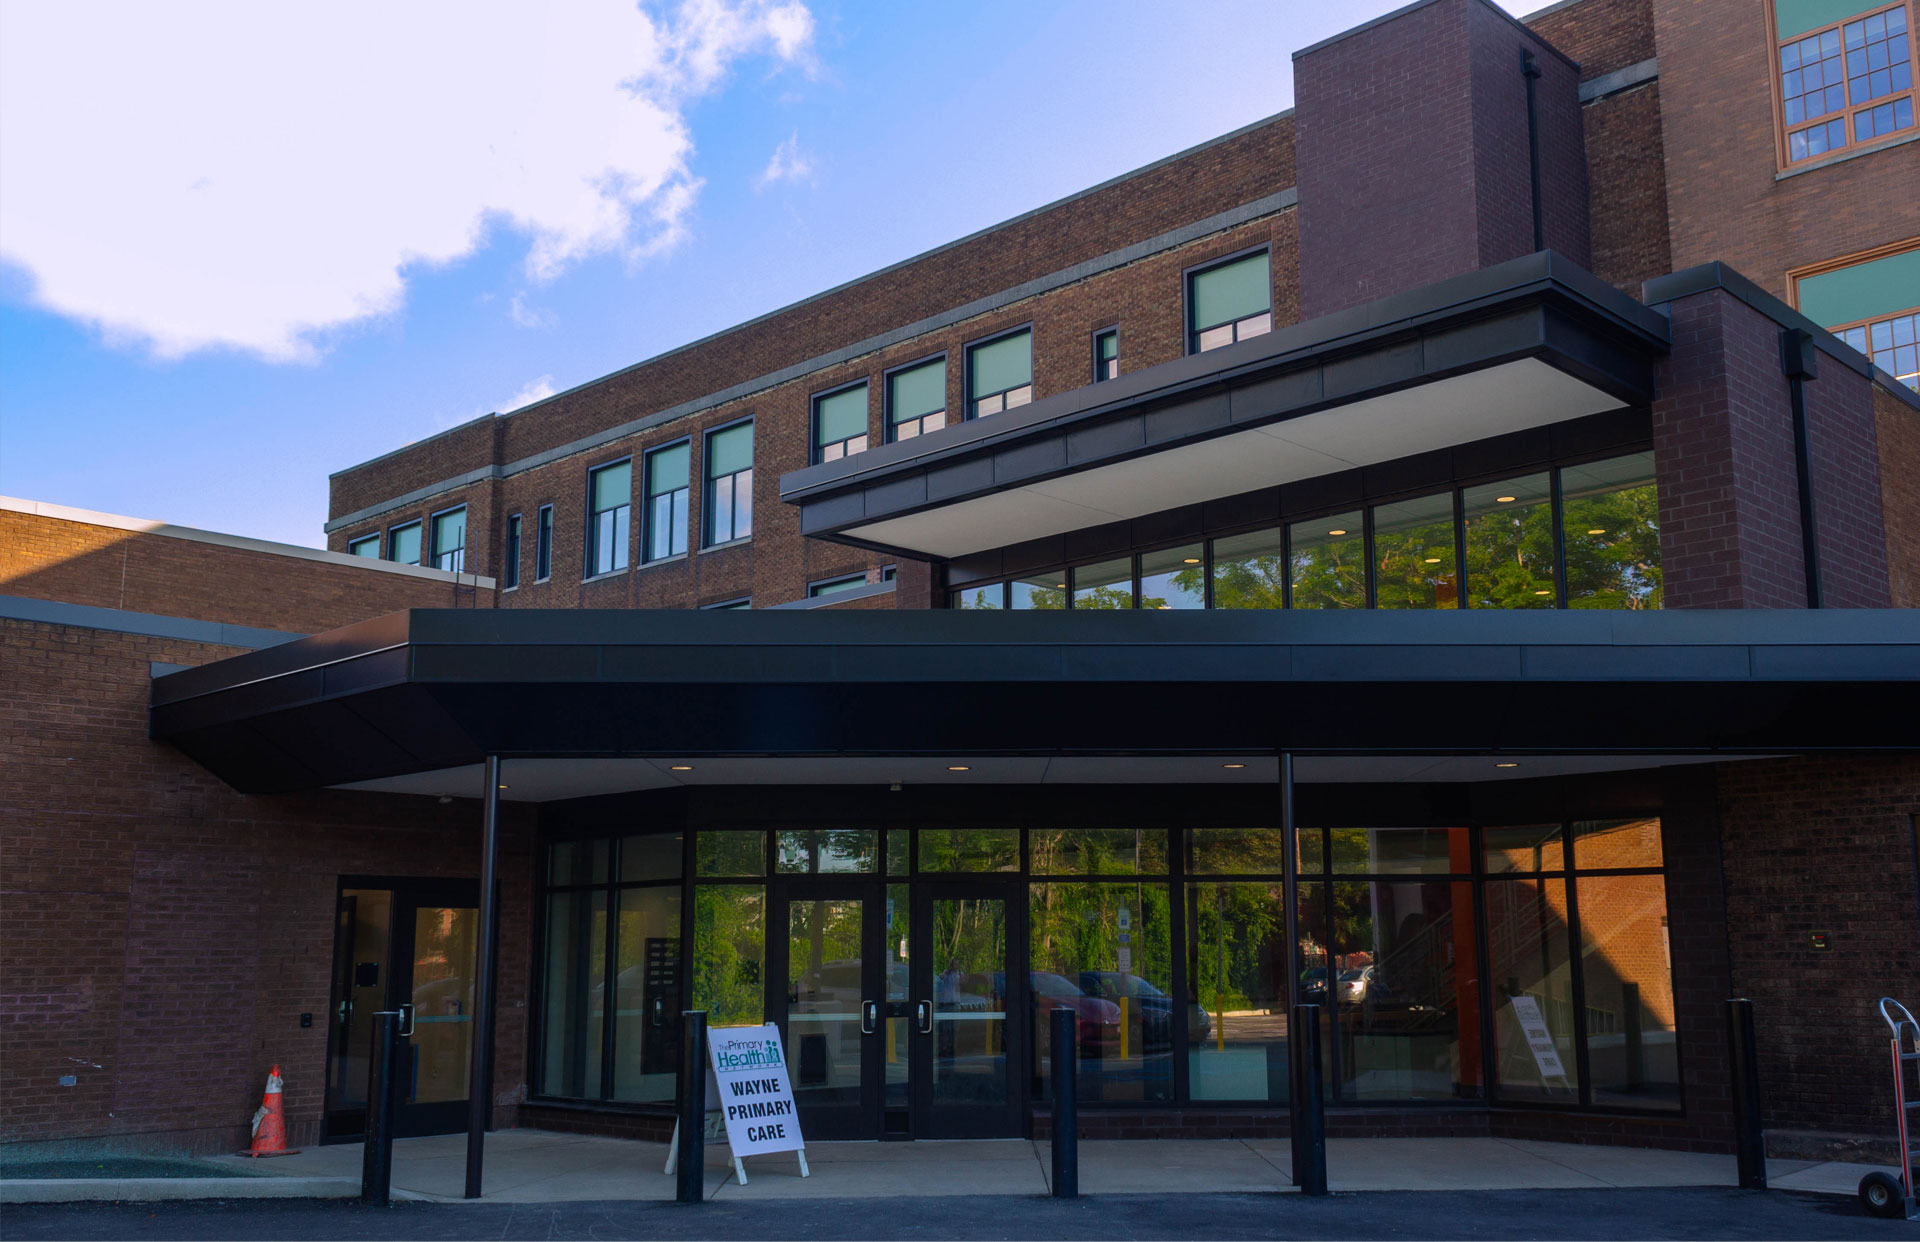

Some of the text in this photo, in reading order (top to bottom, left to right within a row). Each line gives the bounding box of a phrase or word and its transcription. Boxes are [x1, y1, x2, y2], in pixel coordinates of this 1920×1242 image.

[728, 1040, 763, 1051] Primary
[717, 1049, 766, 1067] Health
[730, 1078, 781, 1097] WAYNE
[727, 1100, 792, 1121] PRIMARY
[747, 1124, 786, 1142] CARE
